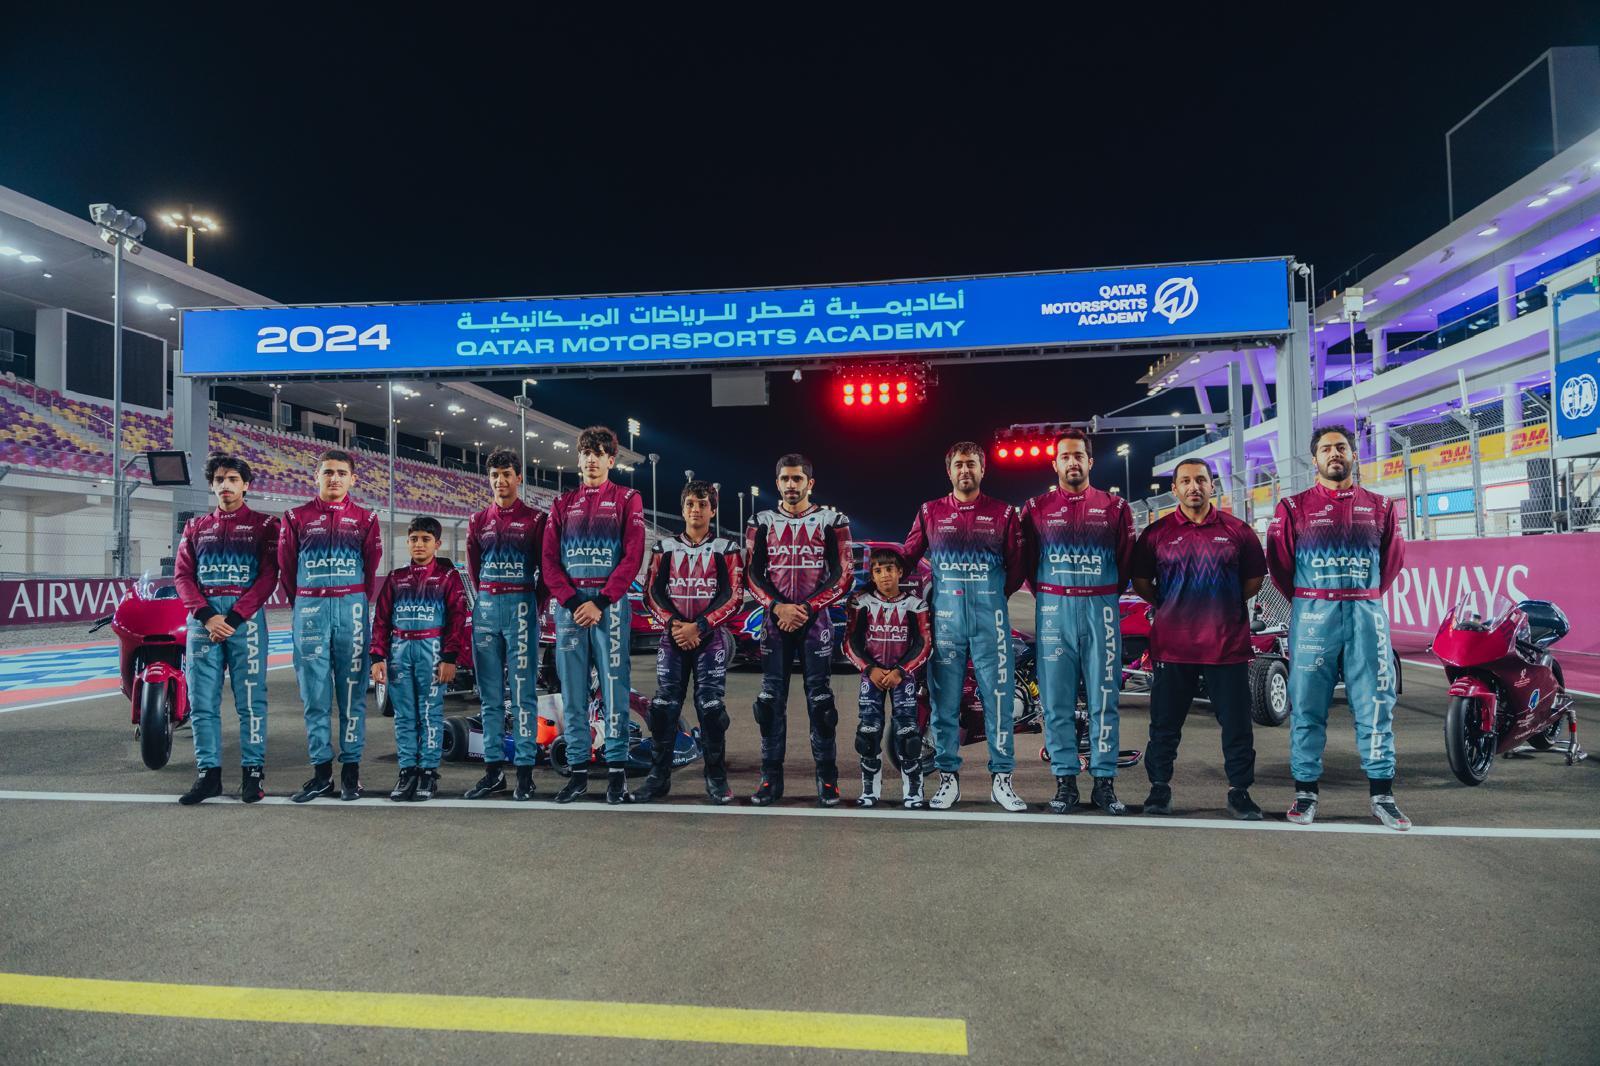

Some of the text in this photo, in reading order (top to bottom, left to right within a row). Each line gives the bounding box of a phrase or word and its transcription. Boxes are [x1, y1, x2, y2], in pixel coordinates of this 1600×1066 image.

[1099, 283, 1147, 298] QATAR
[457, 289, 964, 333] أكاديمية قطر للرياضات الميكانيكية
[1041, 298, 1147, 315] MOTORSPORTS
[1078, 311, 1147, 326] ACADEMY
[257, 324, 390, 353] 2024
[456, 320, 965, 356] QATAR MOTORSPORTS ACADEMY
[1384, 460, 1404, 476] DH
[567, 548, 612, 557] QATAR
[768, 545, 825, 555] QATAR
[305, 558, 356, 568] QATAR
[566, 556, 612, 571] قطر
[768, 556, 824, 571] قطر
[940, 562, 990, 571] QATAR
[1049, 554, 1102, 564] QATAR
[1311, 557, 1371, 568] QATAR
[200, 564, 250, 574] QATAR
[306, 567, 356, 581] قطر
[1051, 565, 1102, 576] قطر
[1313, 567, 1368, 581] قطر
[941, 572, 988, 582] قطر
[396, 605, 435, 613] QATAR
[246, 611, 259, 675] ATAR
[351, 603, 363, 672] QATAR
[518, 602, 528, 669] QATAR
[995, 609, 1008, 684] QATAR
[1102, 606, 1115, 681] QATAR
[1373, 613, 1390, 691] QATAR
